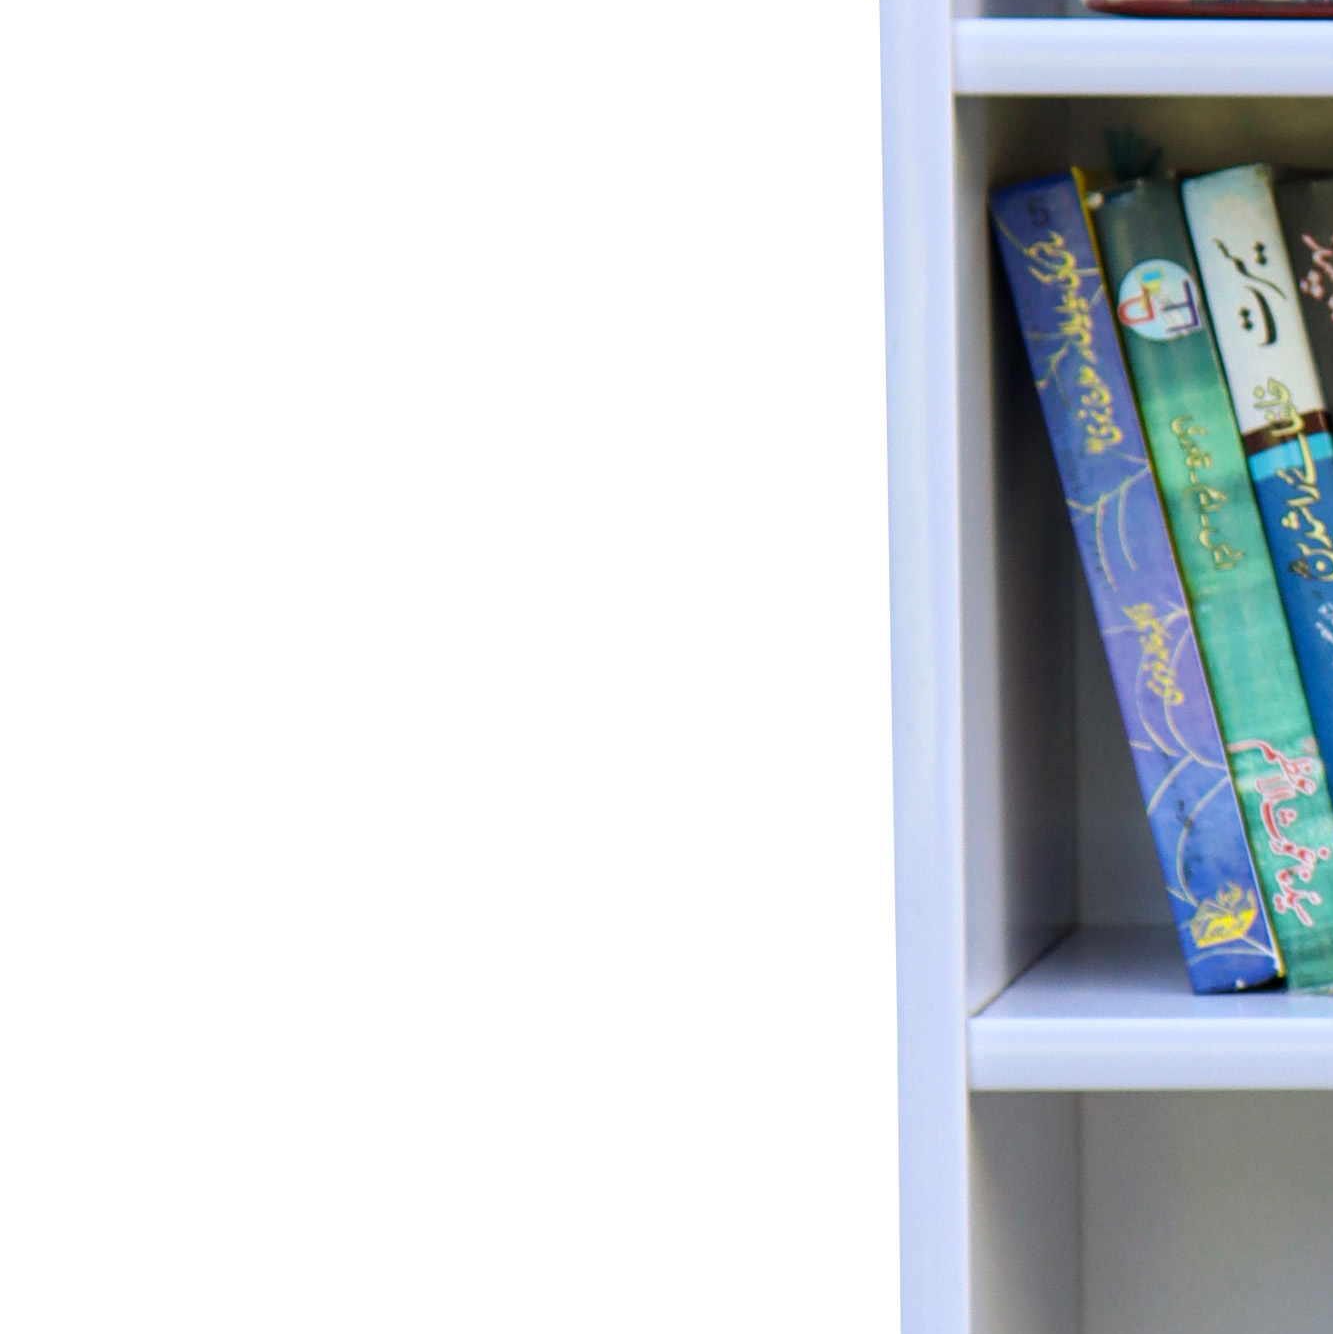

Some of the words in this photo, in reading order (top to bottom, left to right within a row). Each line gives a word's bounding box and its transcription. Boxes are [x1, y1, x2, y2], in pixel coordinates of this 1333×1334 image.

[1217, 240, 1284, 346] سیرت
[1258, 377, 1315, 495] خلفائے
[1262, 788, 1329, 873] غوث
